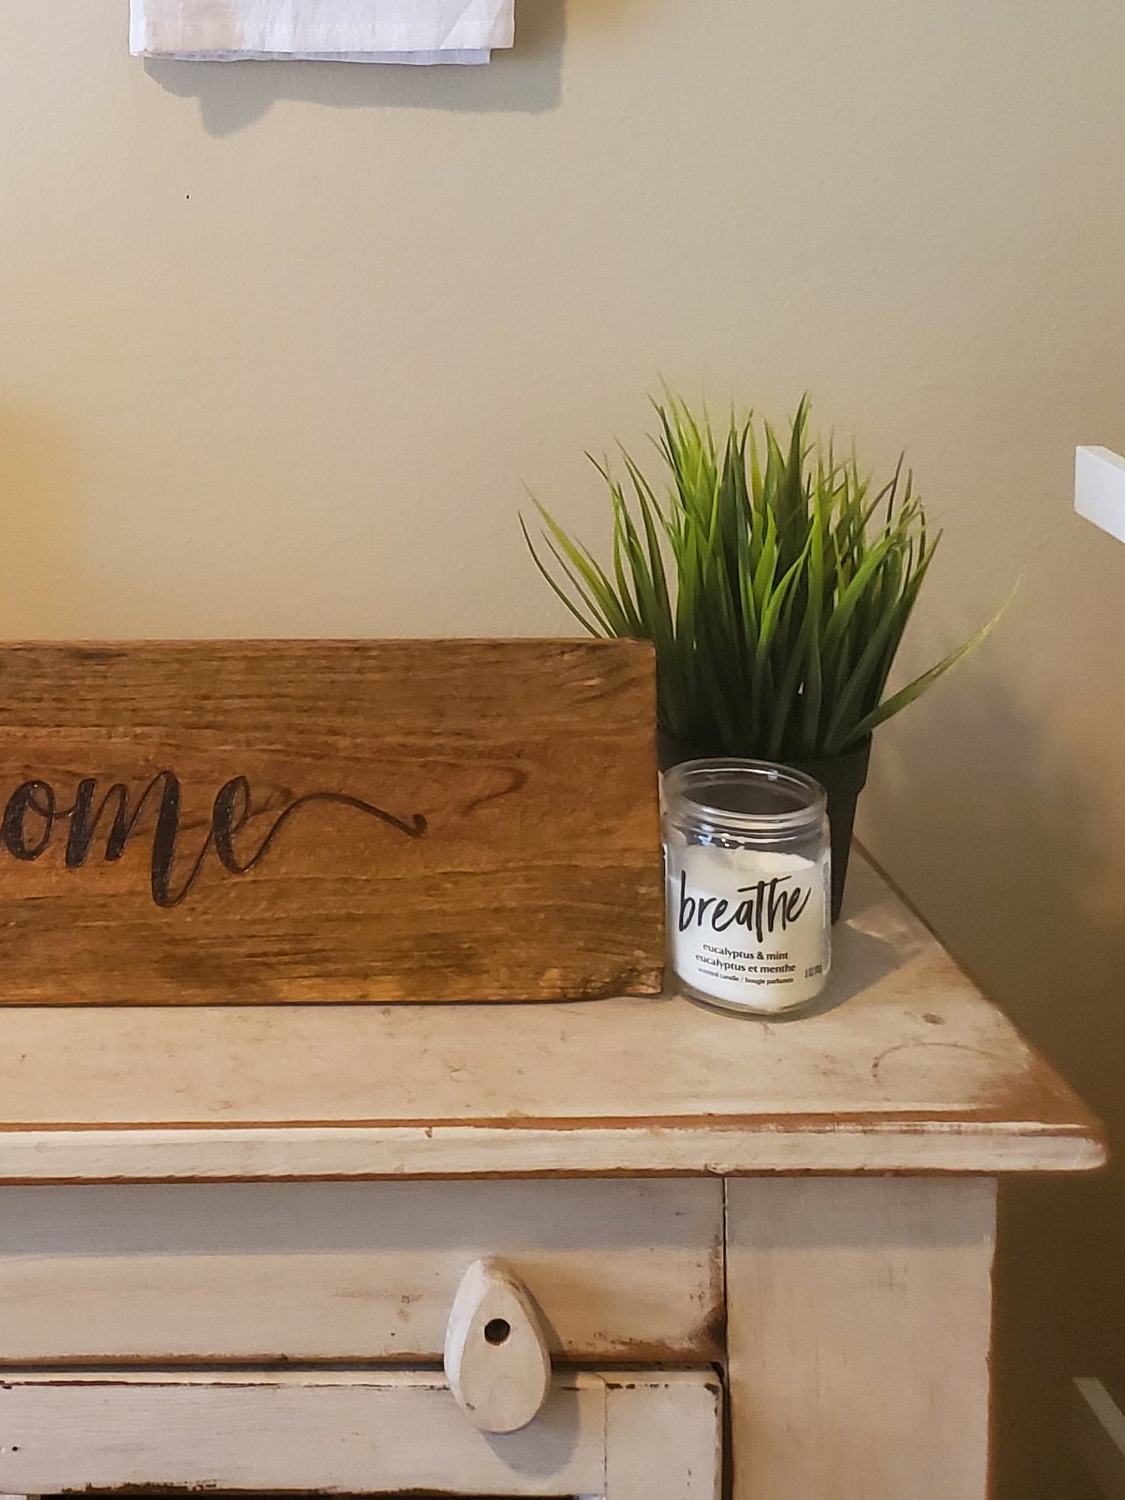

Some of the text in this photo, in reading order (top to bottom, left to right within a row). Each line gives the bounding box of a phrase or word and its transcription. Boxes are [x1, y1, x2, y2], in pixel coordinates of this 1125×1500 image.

[678, 869, 812, 943] breathe
[702, 943, 789, 960] eucalyptus & mint
[695, 953, 746, 972] eucalyptus
[748, 964, 759, 973] et
[760, 963, 796, 973] menthe
